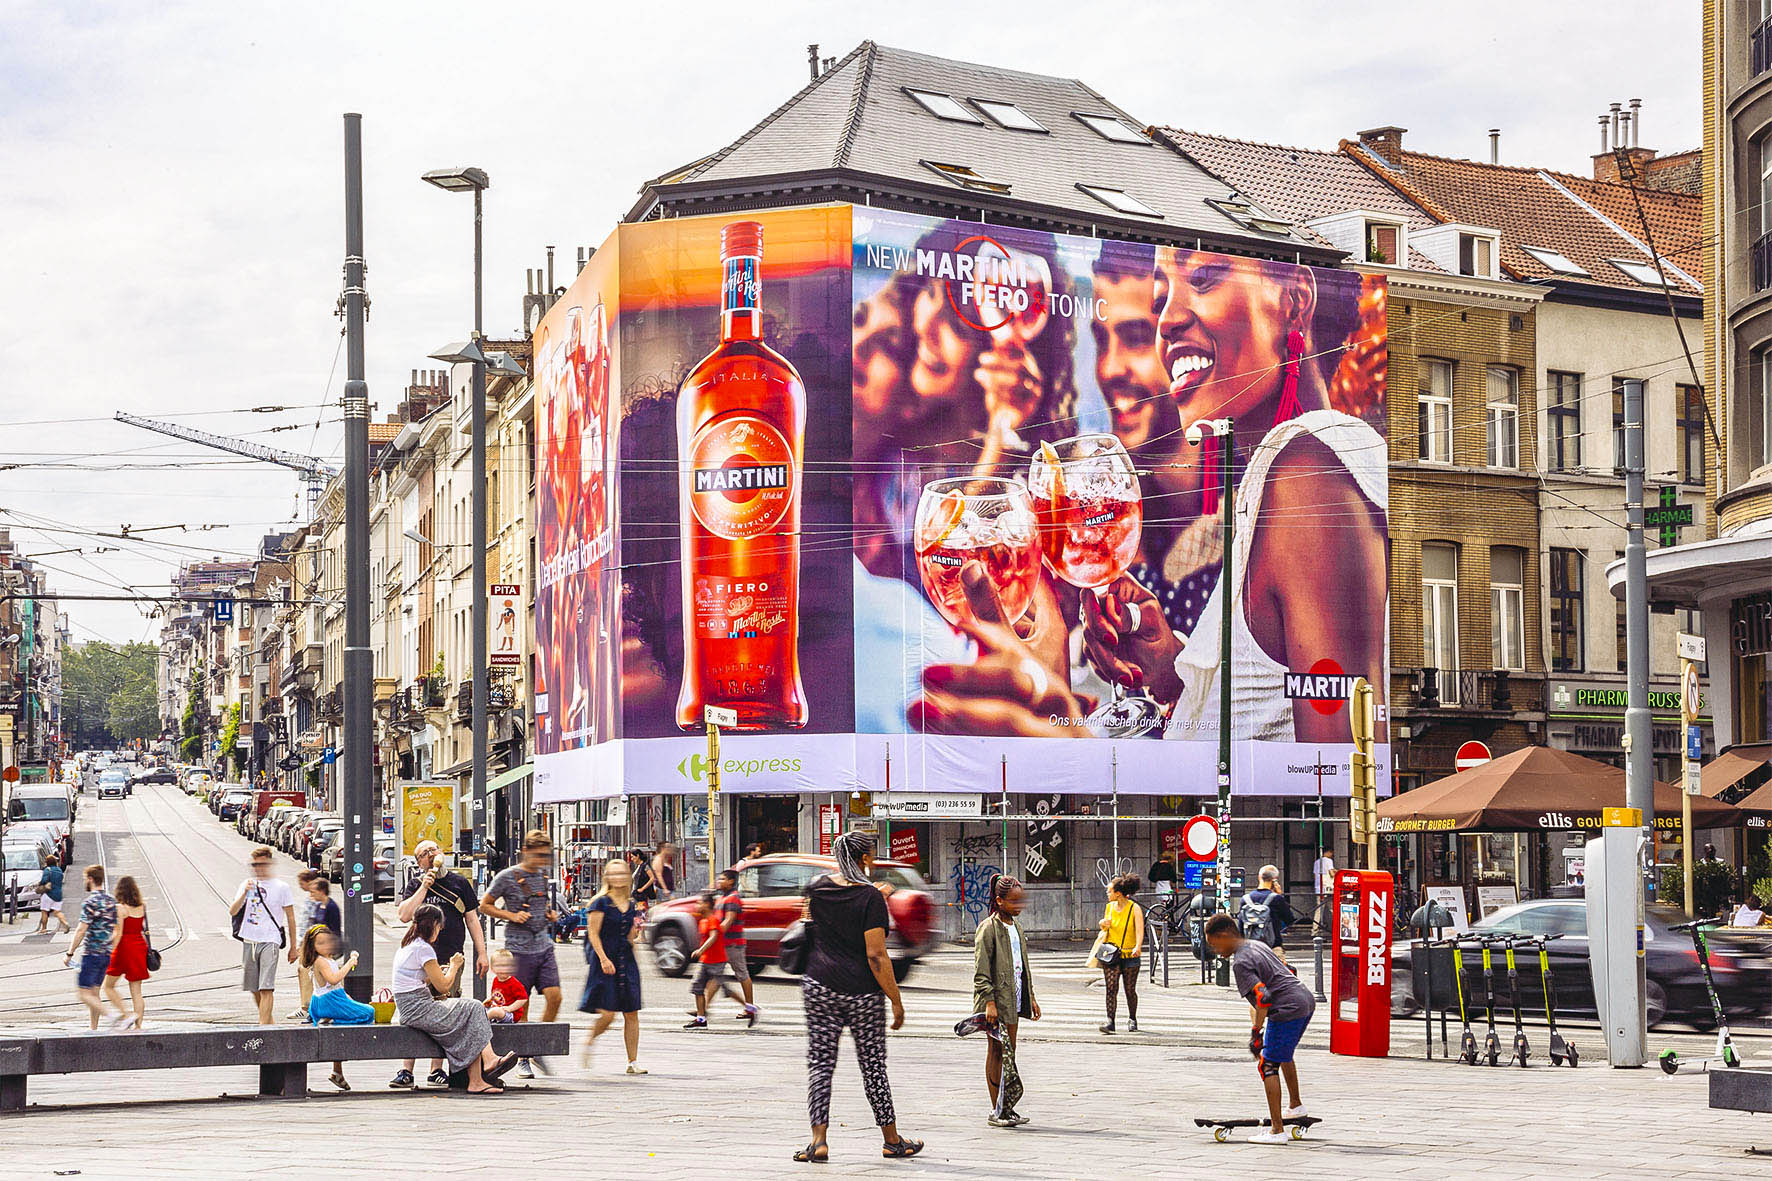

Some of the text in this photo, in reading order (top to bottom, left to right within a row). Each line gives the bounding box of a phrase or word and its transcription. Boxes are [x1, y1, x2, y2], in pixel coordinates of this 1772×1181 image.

[867, 244, 1028, 289] NEW MARTINI
[961, 283, 1029, 312] FIERO
[1047, 292, 1109, 322] TONIC
[711, 372, 770, 385] ITALIA
[697, 466, 784, 490] MARTINI
[1086, 512, 1115, 527] MARTINI
[931, 554, 962, 567] MARTINI
[494, 585, 517, 595] PITA
[716, 582, 769, 594] FIERO
[1049, 713, 1071, 727] Ons
[1072, 714, 1138, 730] vakmanschap
[1139, 715, 1163, 728] drink
[1163, 717, 1174, 731] je
[1175, 718, 1194, 730] met
[325, 749, 333, 758] P
[724, 757, 802, 778] express
[935, 800, 948, 808] (03)
[948, 800, 959, 808] 236
[960, 800, 968, 808] 55
[968, 800, 976, 808] 59
[1376, 817, 1456, 832] ellis GOURMET BURGER
[1539, 812, 1573, 828] ellis
[1747, 816, 1766, 828] ellis
[892, 835, 914, 846] Ouvert
[1367, 891, 1387, 986] BRUZZ
